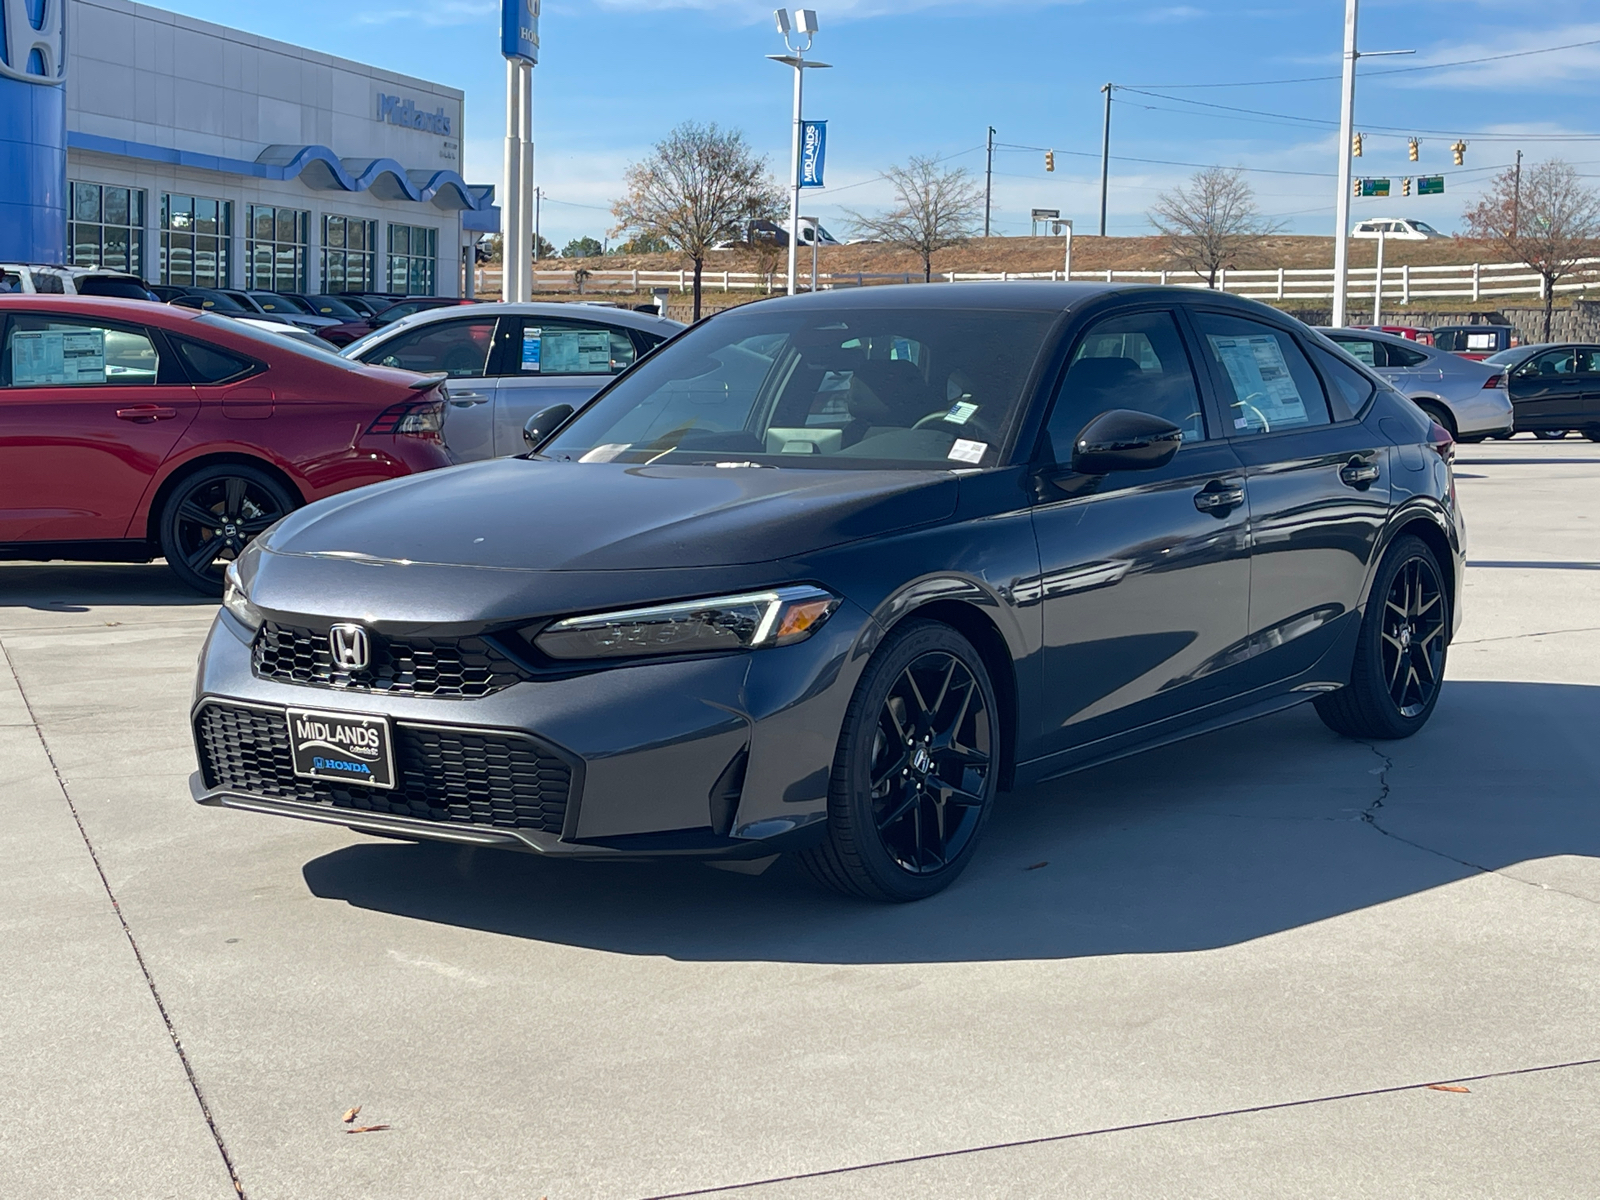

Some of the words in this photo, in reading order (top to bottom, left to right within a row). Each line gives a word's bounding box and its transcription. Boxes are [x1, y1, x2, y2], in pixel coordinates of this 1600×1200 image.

[377, 93, 451, 136] Midlands
[804, 125, 815, 181] MIDLANDS
[296, 719, 379, 747] MIDLANDS
[325, 760, 371, 774] HONDA
